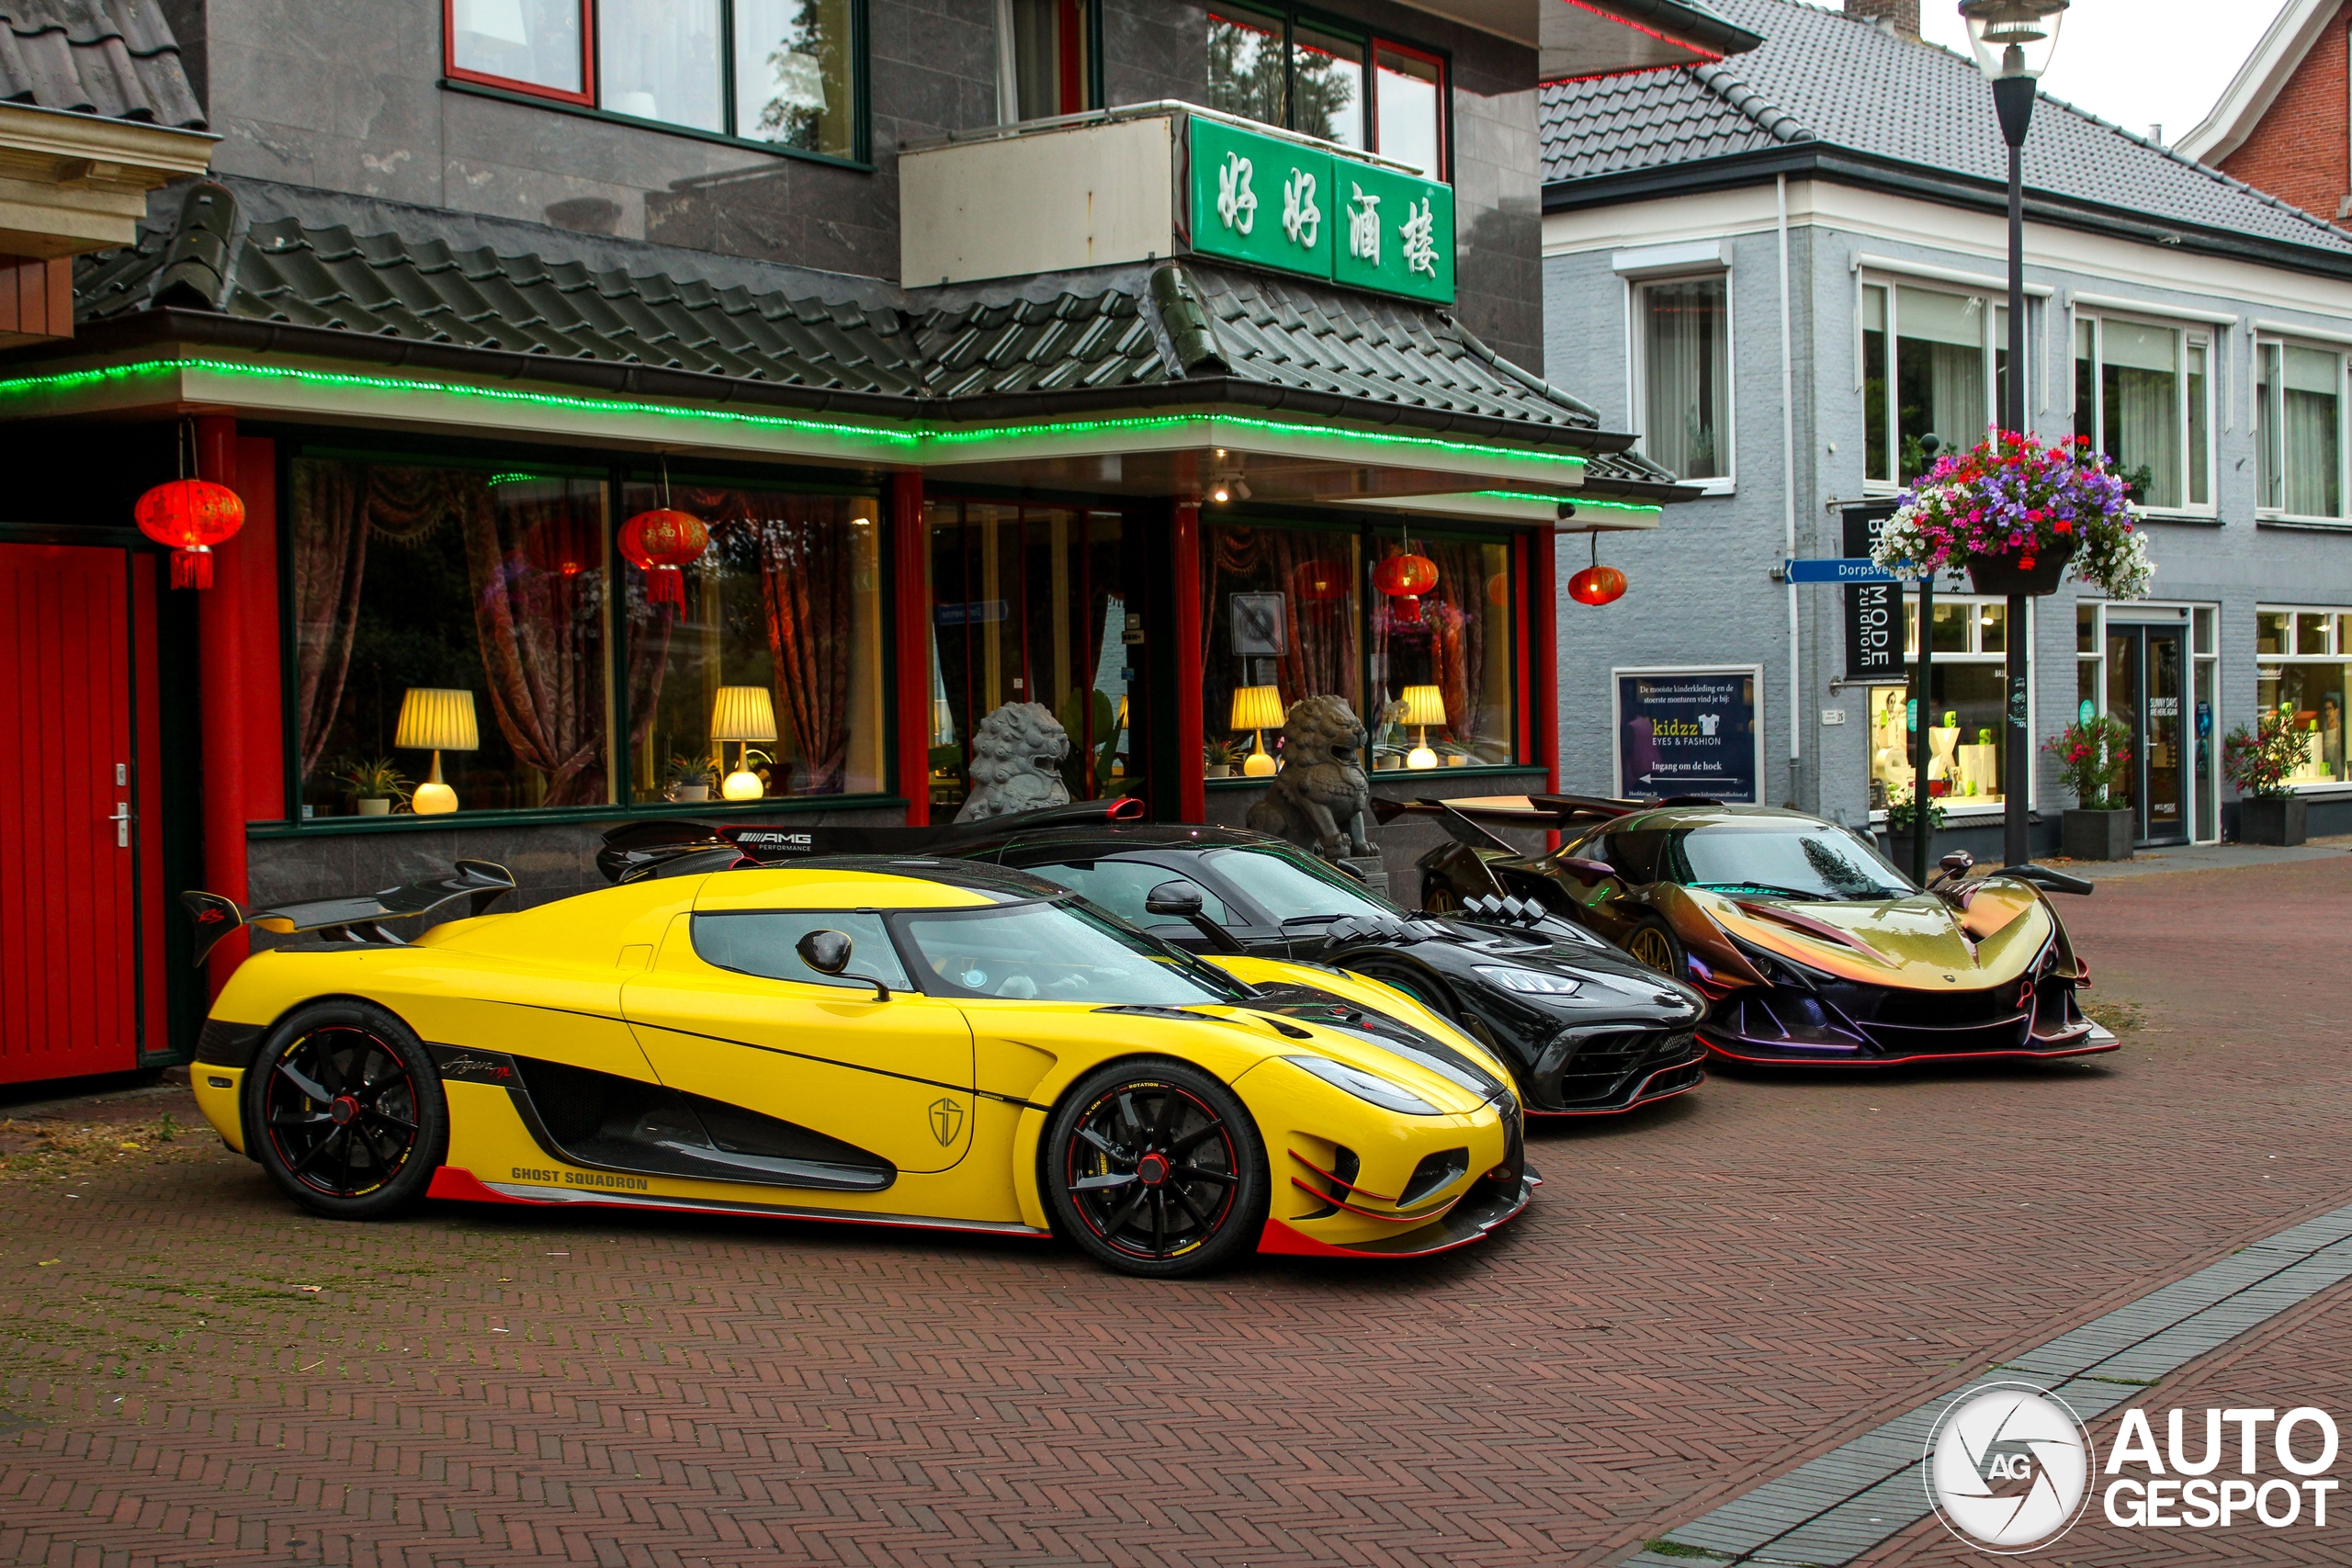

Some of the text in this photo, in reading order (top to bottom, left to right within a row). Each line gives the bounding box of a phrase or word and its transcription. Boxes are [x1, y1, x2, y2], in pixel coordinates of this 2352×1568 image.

[1859, 587, 1873, 667] zuidhorn
[1640, 685, 1648, 694] De
[1673, 684, 1716, 694] kinderkleding
[1725, 683, 1734, 692] de
[1697, 694, 1711, 703] vind
[1712, 695, 1718, 705] je
[1719, 694, 1730, 705] bij:
[1652, 717, 1699, 736] kidzz
[1652, 737, 1721, 746] EYES & FASHION
[1652, 761, 1678, 773] Ingang
[1692, 761, 1702, 770] de
[1702, 761, 1723, 770] hoek
[761, 833, 812, 843] AMG
[441, 1054, 498, 1075] Agera
[512, 1167, 649, 1190] GHOST SQUADRON
